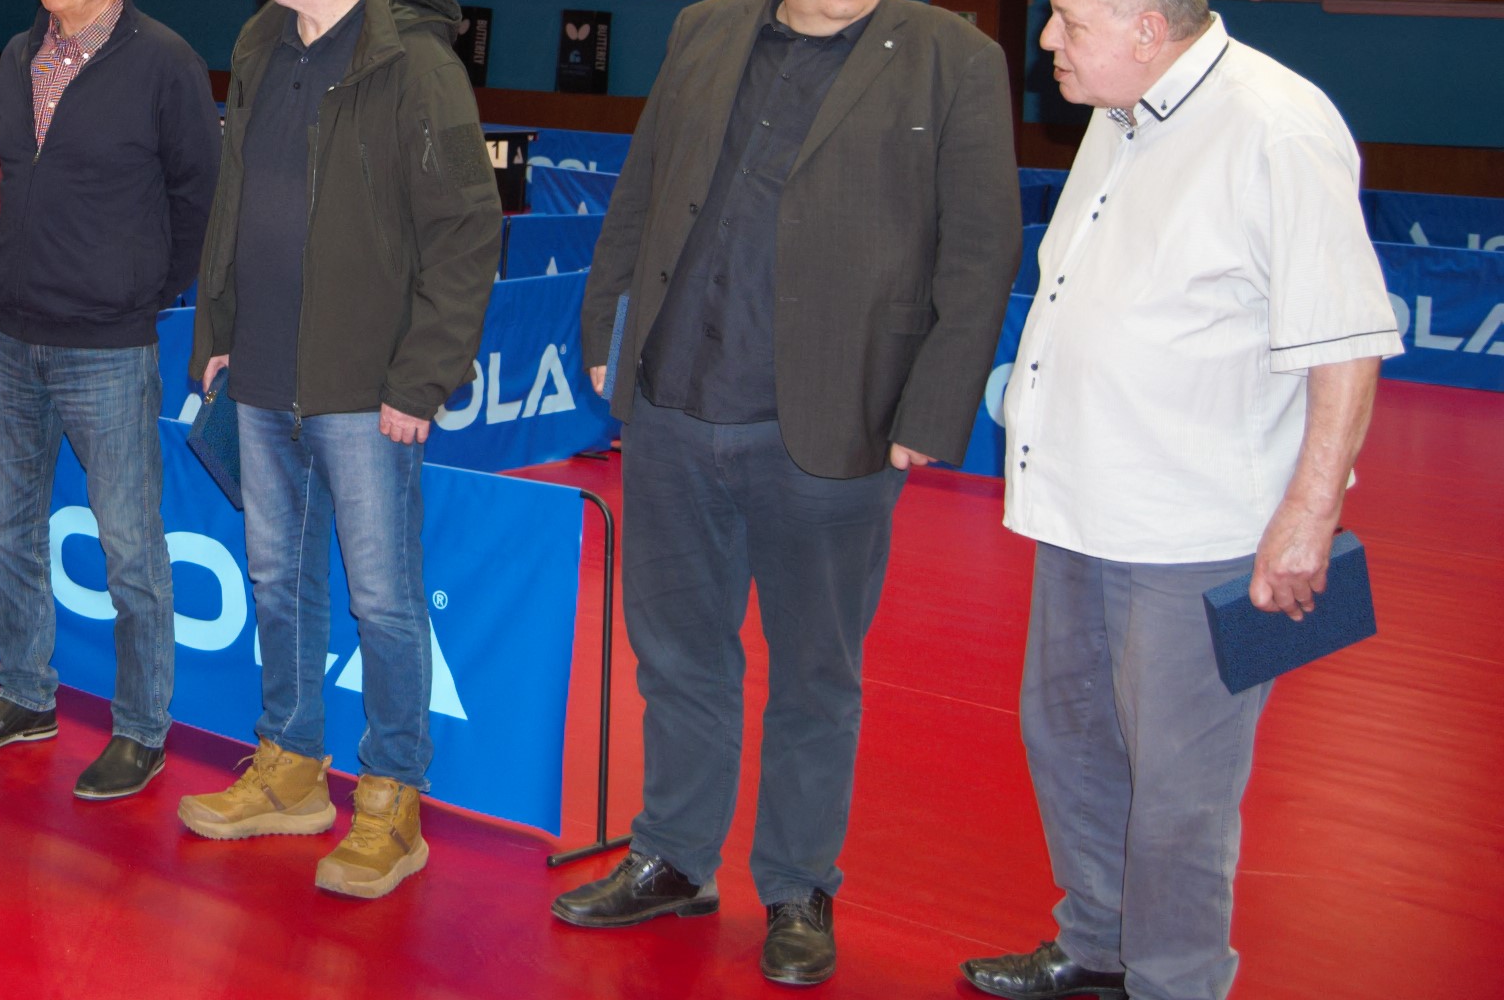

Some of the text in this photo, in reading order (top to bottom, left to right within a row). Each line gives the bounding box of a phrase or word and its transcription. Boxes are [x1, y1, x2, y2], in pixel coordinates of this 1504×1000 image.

[474, 19, 488, 64] BUTTERFLY
[595, 24, 608, 71] BUTTERFLY
[434, 343, 577, 431] OLA
